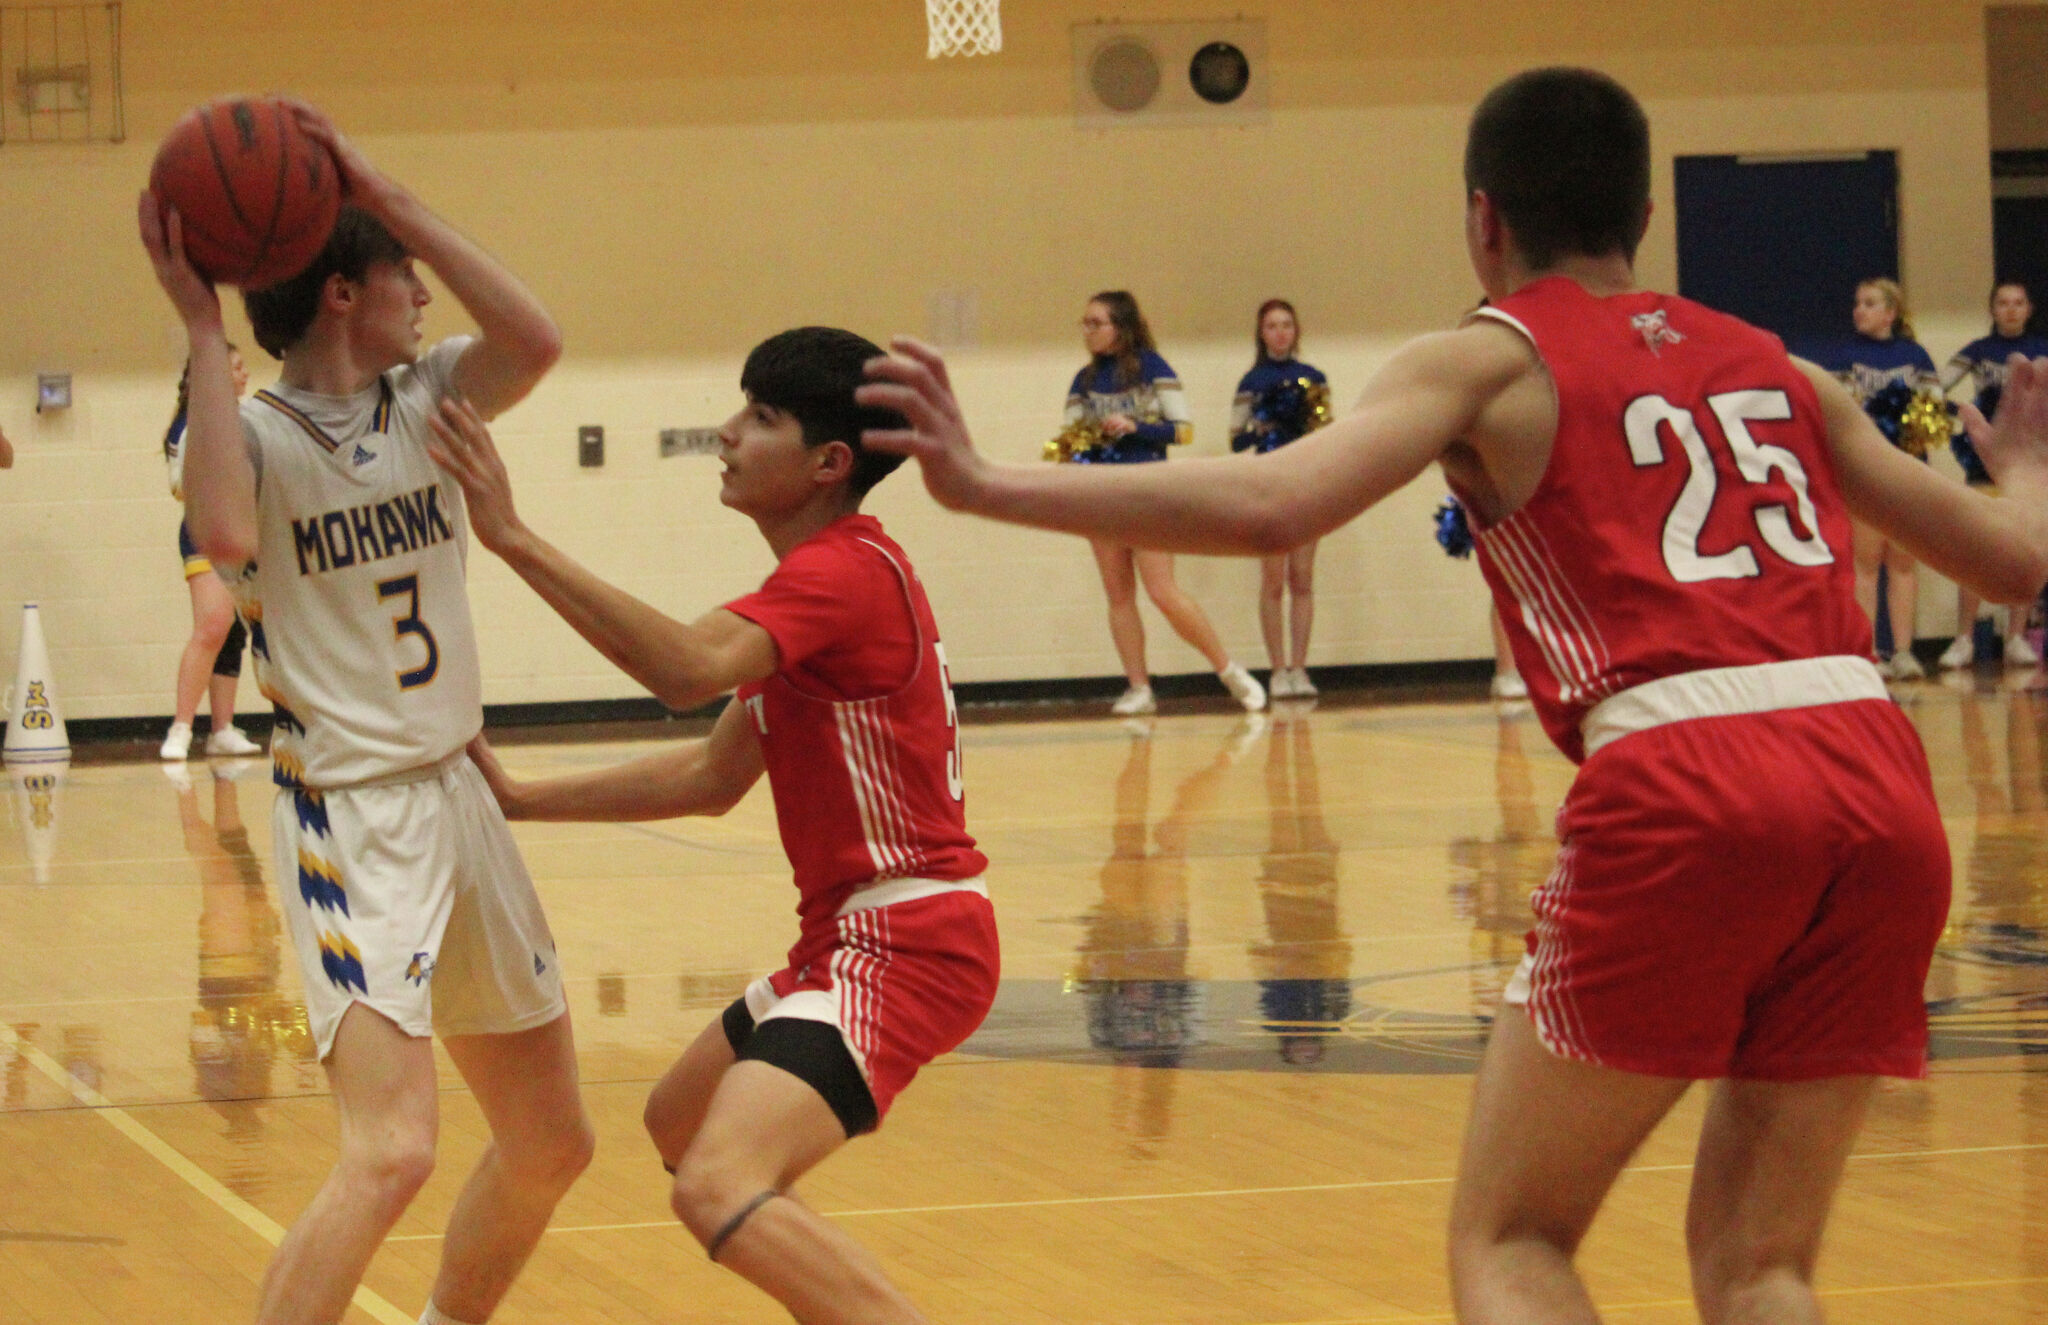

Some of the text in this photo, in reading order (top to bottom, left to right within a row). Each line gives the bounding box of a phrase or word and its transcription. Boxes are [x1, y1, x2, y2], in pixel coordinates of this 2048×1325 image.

[292, 484, 454, 576] MOHAWK
[1624, 389, 1835, 583] 25
[374, 571, 440, 692] 3
